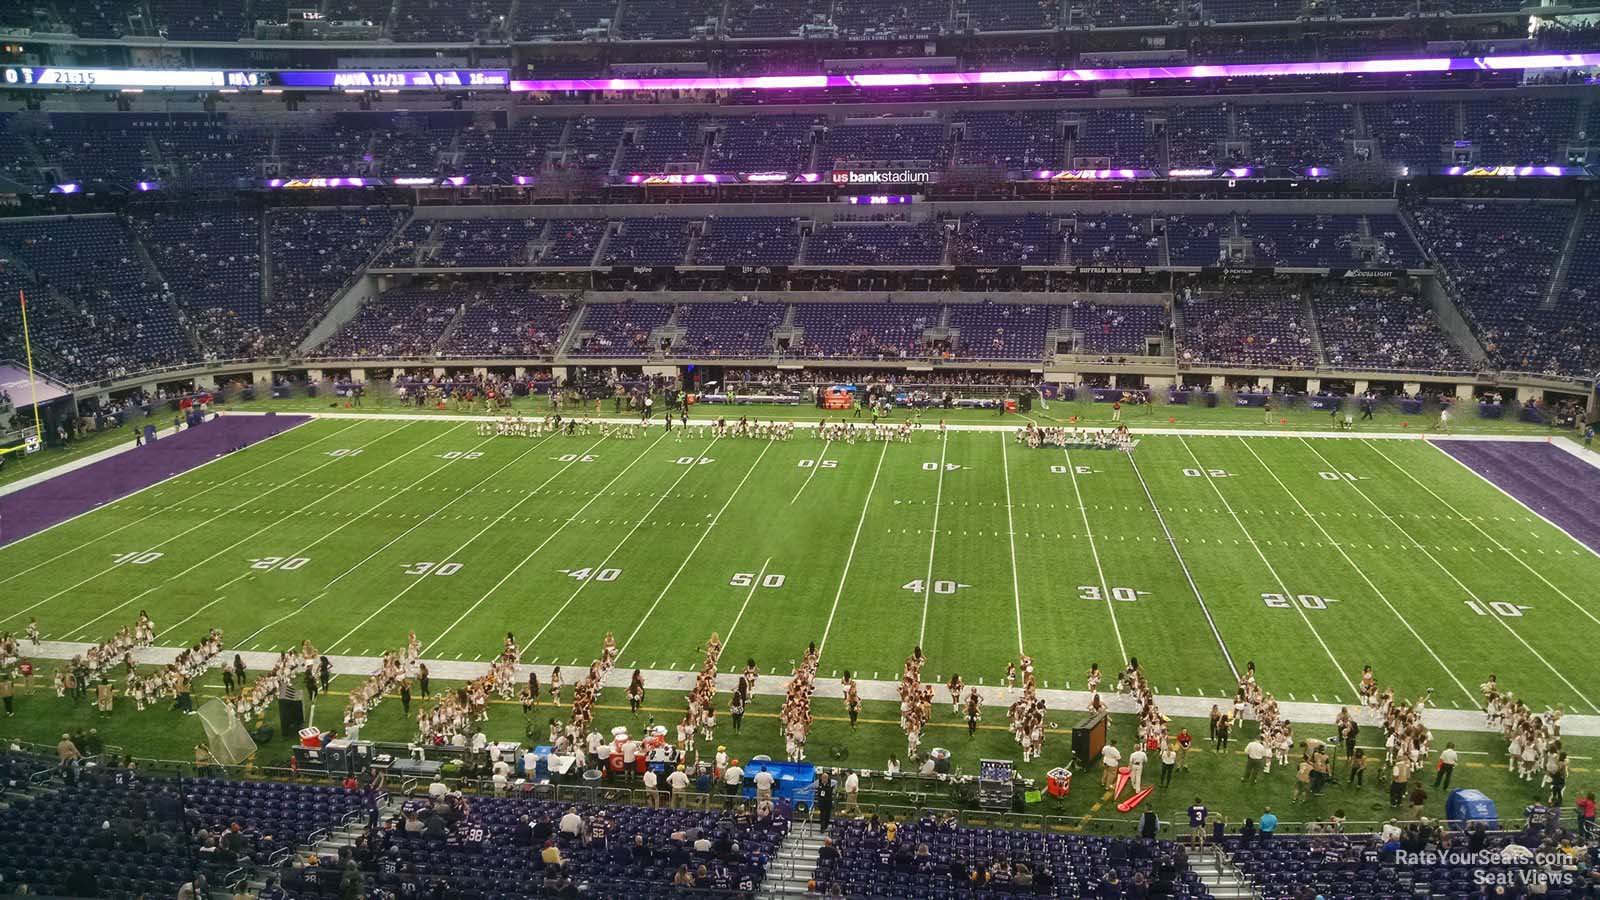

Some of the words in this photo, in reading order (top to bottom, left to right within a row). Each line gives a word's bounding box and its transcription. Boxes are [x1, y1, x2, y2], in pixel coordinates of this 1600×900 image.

[54, 72, 96, 84] 21:15
[116, 552, 164, 564] 10
[251, 556, 311, 570] 20
[404, 562, 464, 577] 30
[566, 567, 623, 582] 40
[729, 573, 786, 588] 50
[902, 579, 958, 595] 40
[1077, 586, 1139, 602] 30
[1261, 593, 1329, 611] 20
[1463, 599, 1524, 617] 10
[1195, 811, 1202, 821] 3
